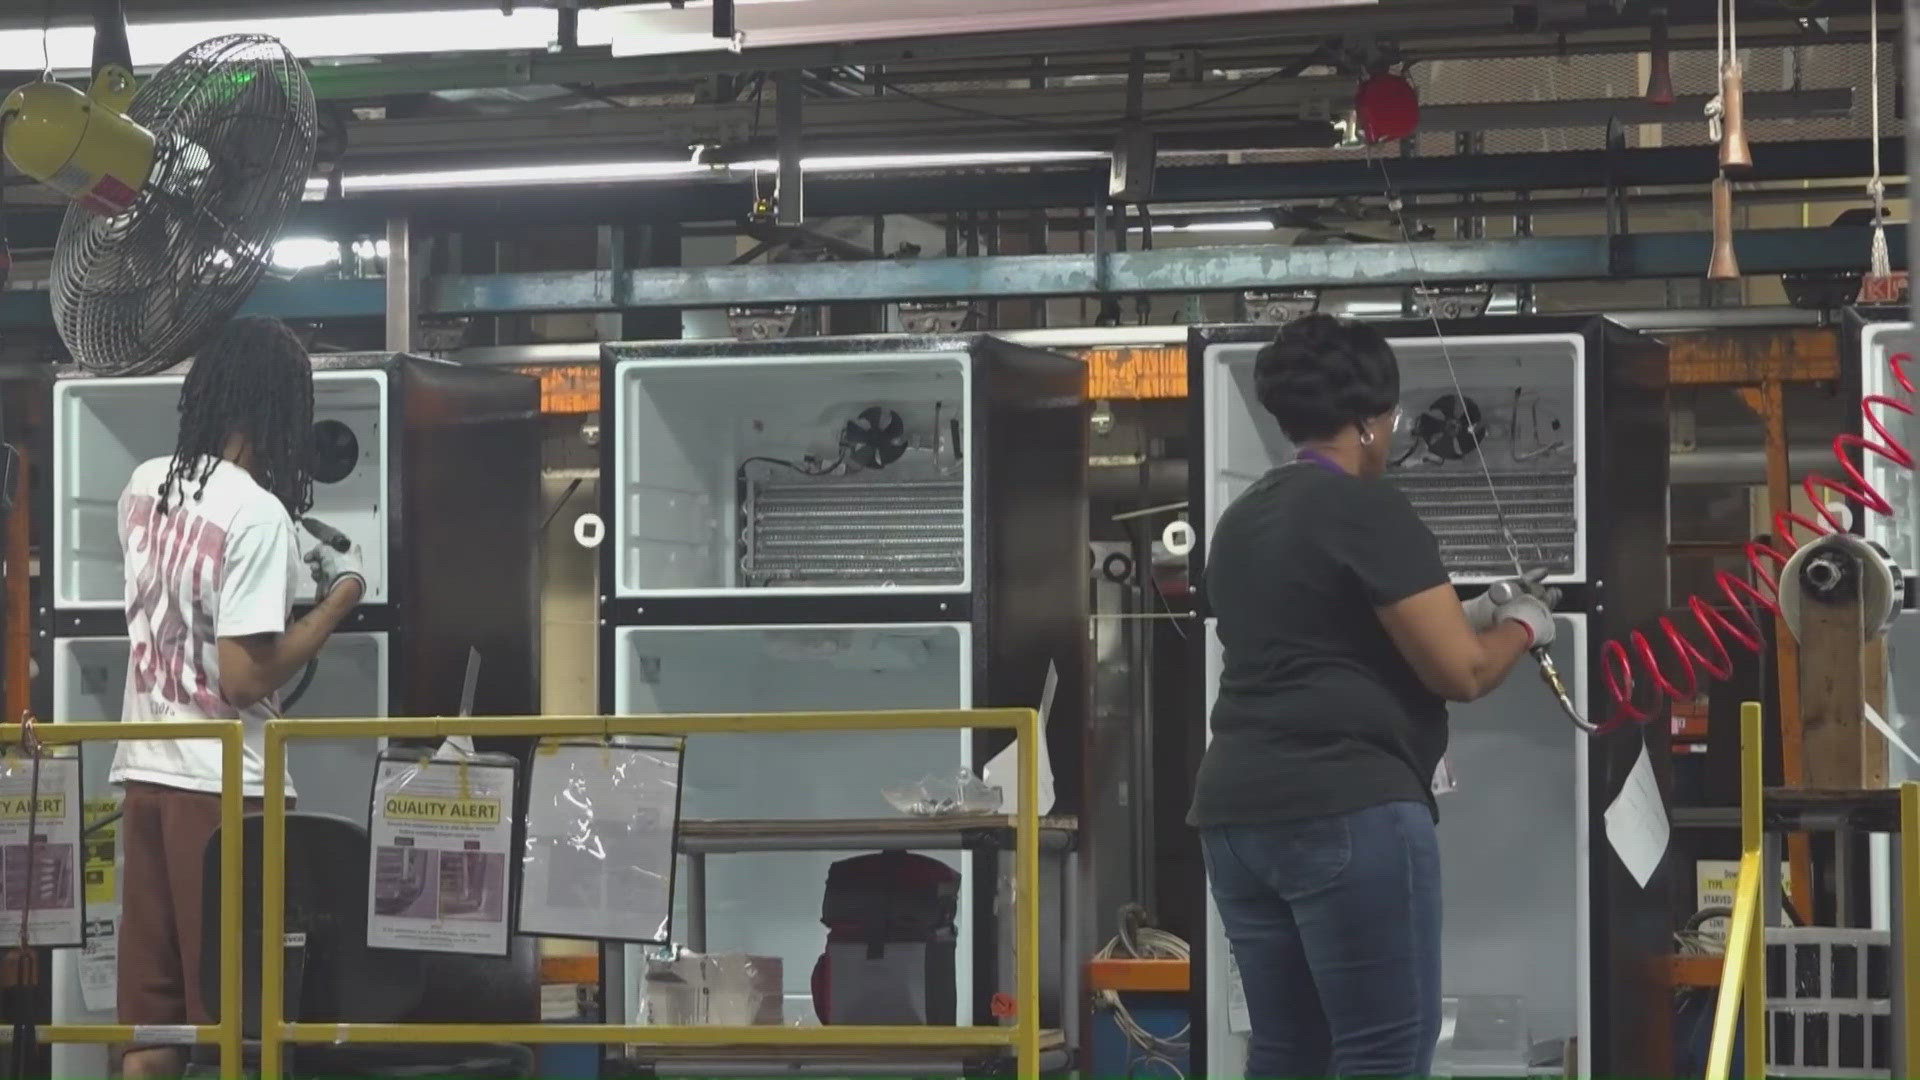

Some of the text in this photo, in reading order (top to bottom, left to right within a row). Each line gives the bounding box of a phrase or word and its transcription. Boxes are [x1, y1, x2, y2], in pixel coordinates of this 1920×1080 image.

[386, 799, 497, 818] QUALITY ALERT
[1703, 895, 1732, 904] STARVED
